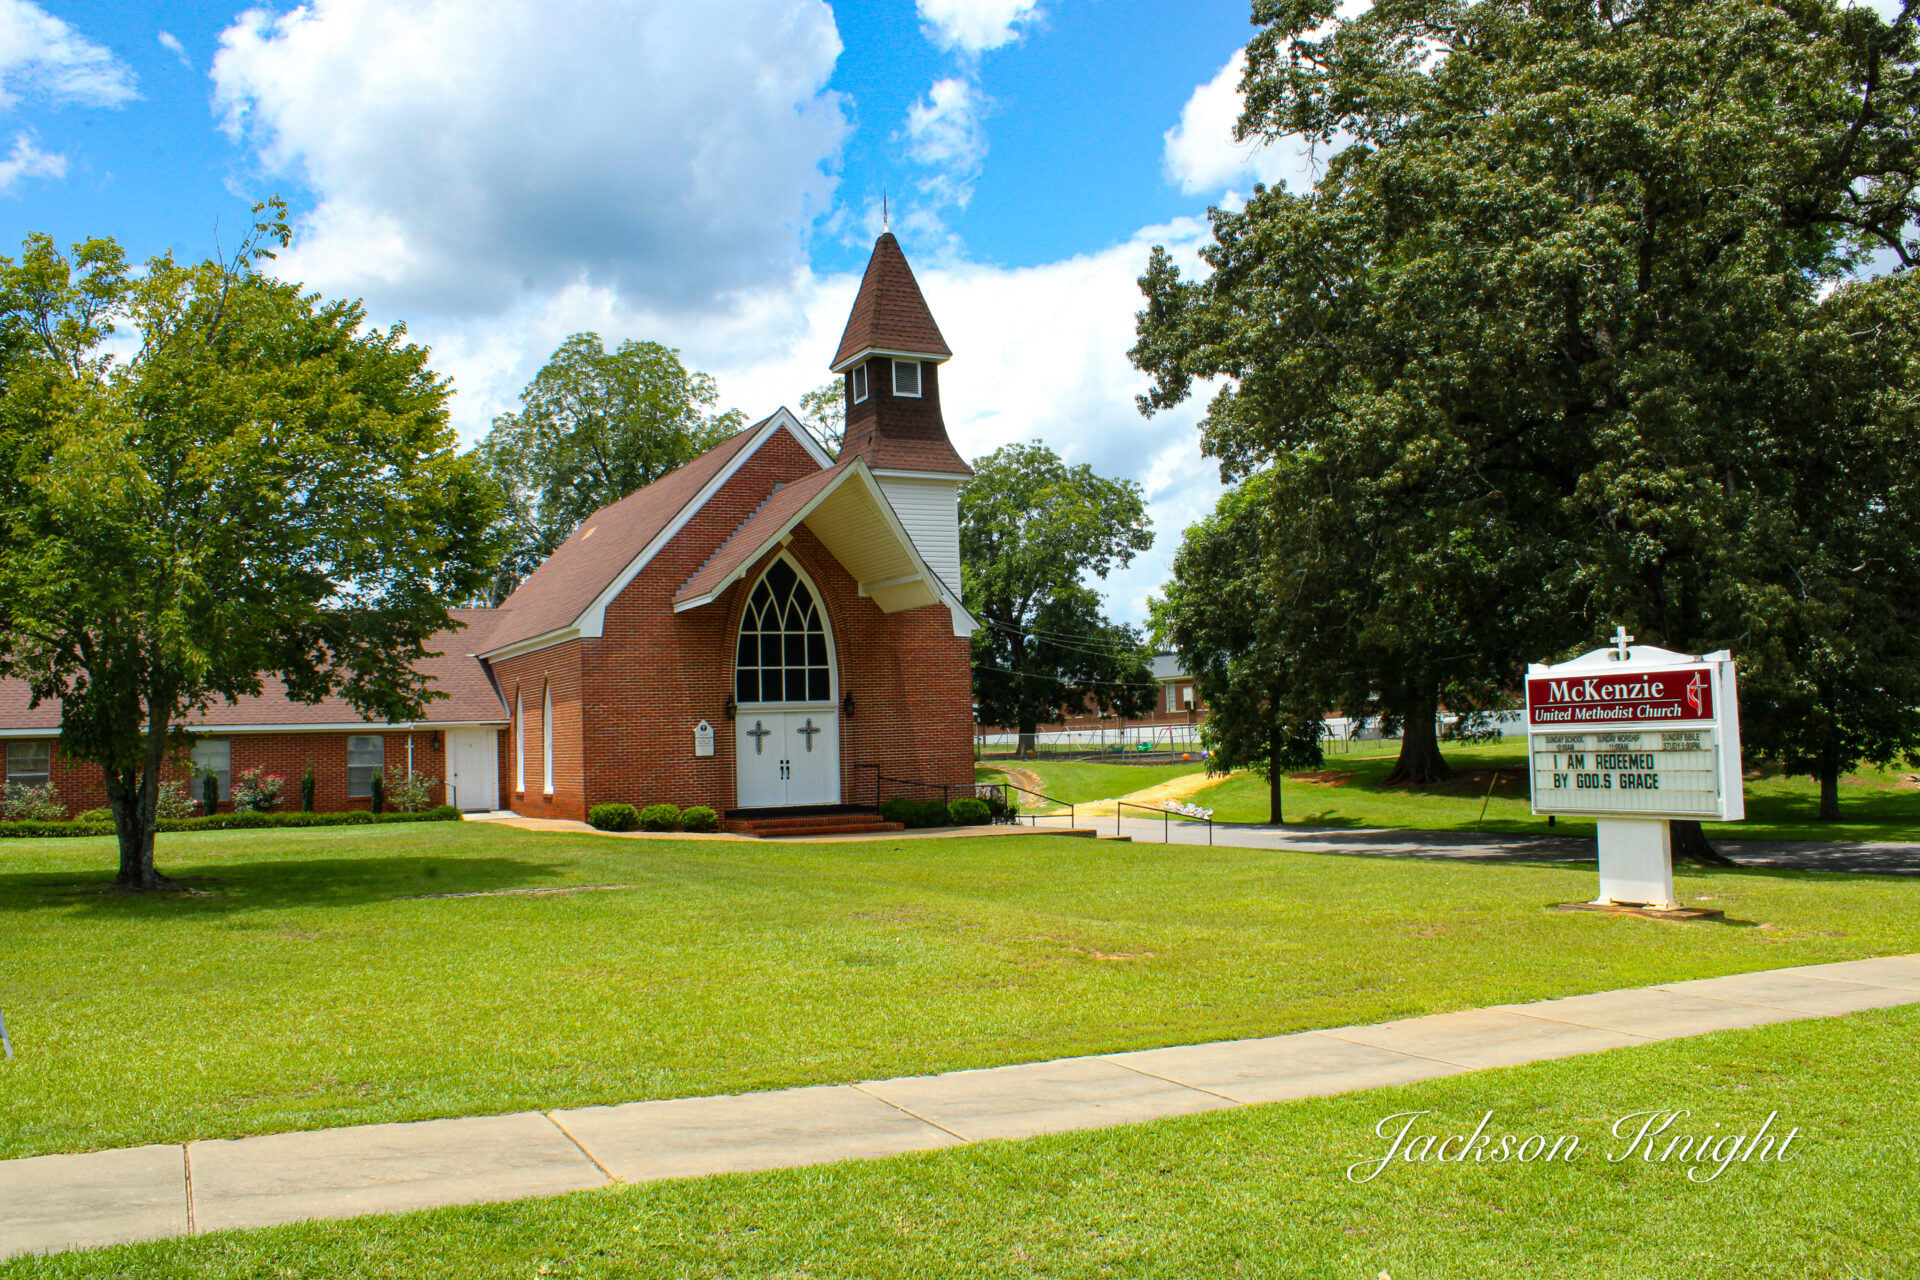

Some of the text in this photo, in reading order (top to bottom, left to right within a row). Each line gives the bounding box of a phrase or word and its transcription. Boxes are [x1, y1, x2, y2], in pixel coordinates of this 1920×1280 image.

[1548, 675, 1665, 702] McKenzie
[1535, 704, 1682, 722] United Methodist Church
[1565, 735, 1584, 743] SCHOOL
[1596, 734, 1640, 743] SUNDAY WORSHIP
[1662, 732, 1700, 741] SUNDAY BIBLE
[1663, 742, 1680, 750] STUDY
[1553, 754, 1654, 770] I AM REDEEMED
[1553, 773, 1568, 788] BY
[1619, 773, 1659, 789] GRACE
